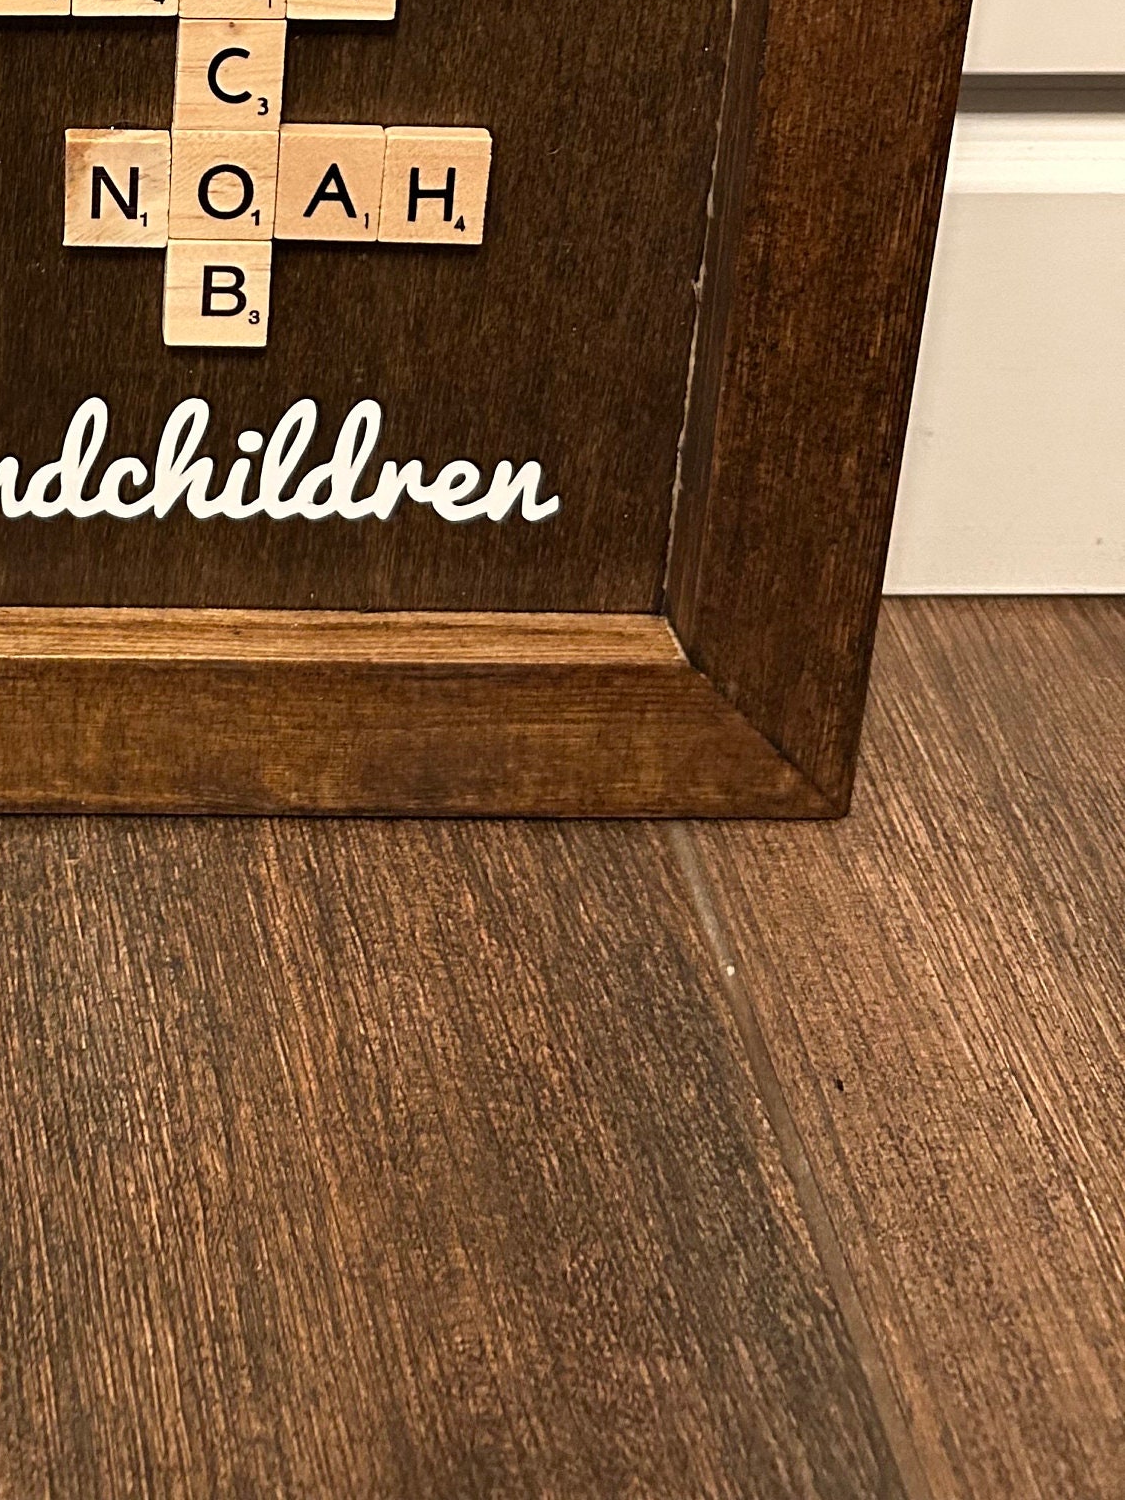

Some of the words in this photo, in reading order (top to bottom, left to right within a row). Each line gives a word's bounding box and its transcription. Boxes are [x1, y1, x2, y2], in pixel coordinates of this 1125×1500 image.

[257, 97, 269, 116] 3
[90, 162, 457, 222] NOAH
[139, 211, 148, 228] 1
[250, 209, 261, 227] 1
[364, 212, 370, 230] 1
[453, 215, 466, 232] 4
[248, 309, 261, 325] 3
